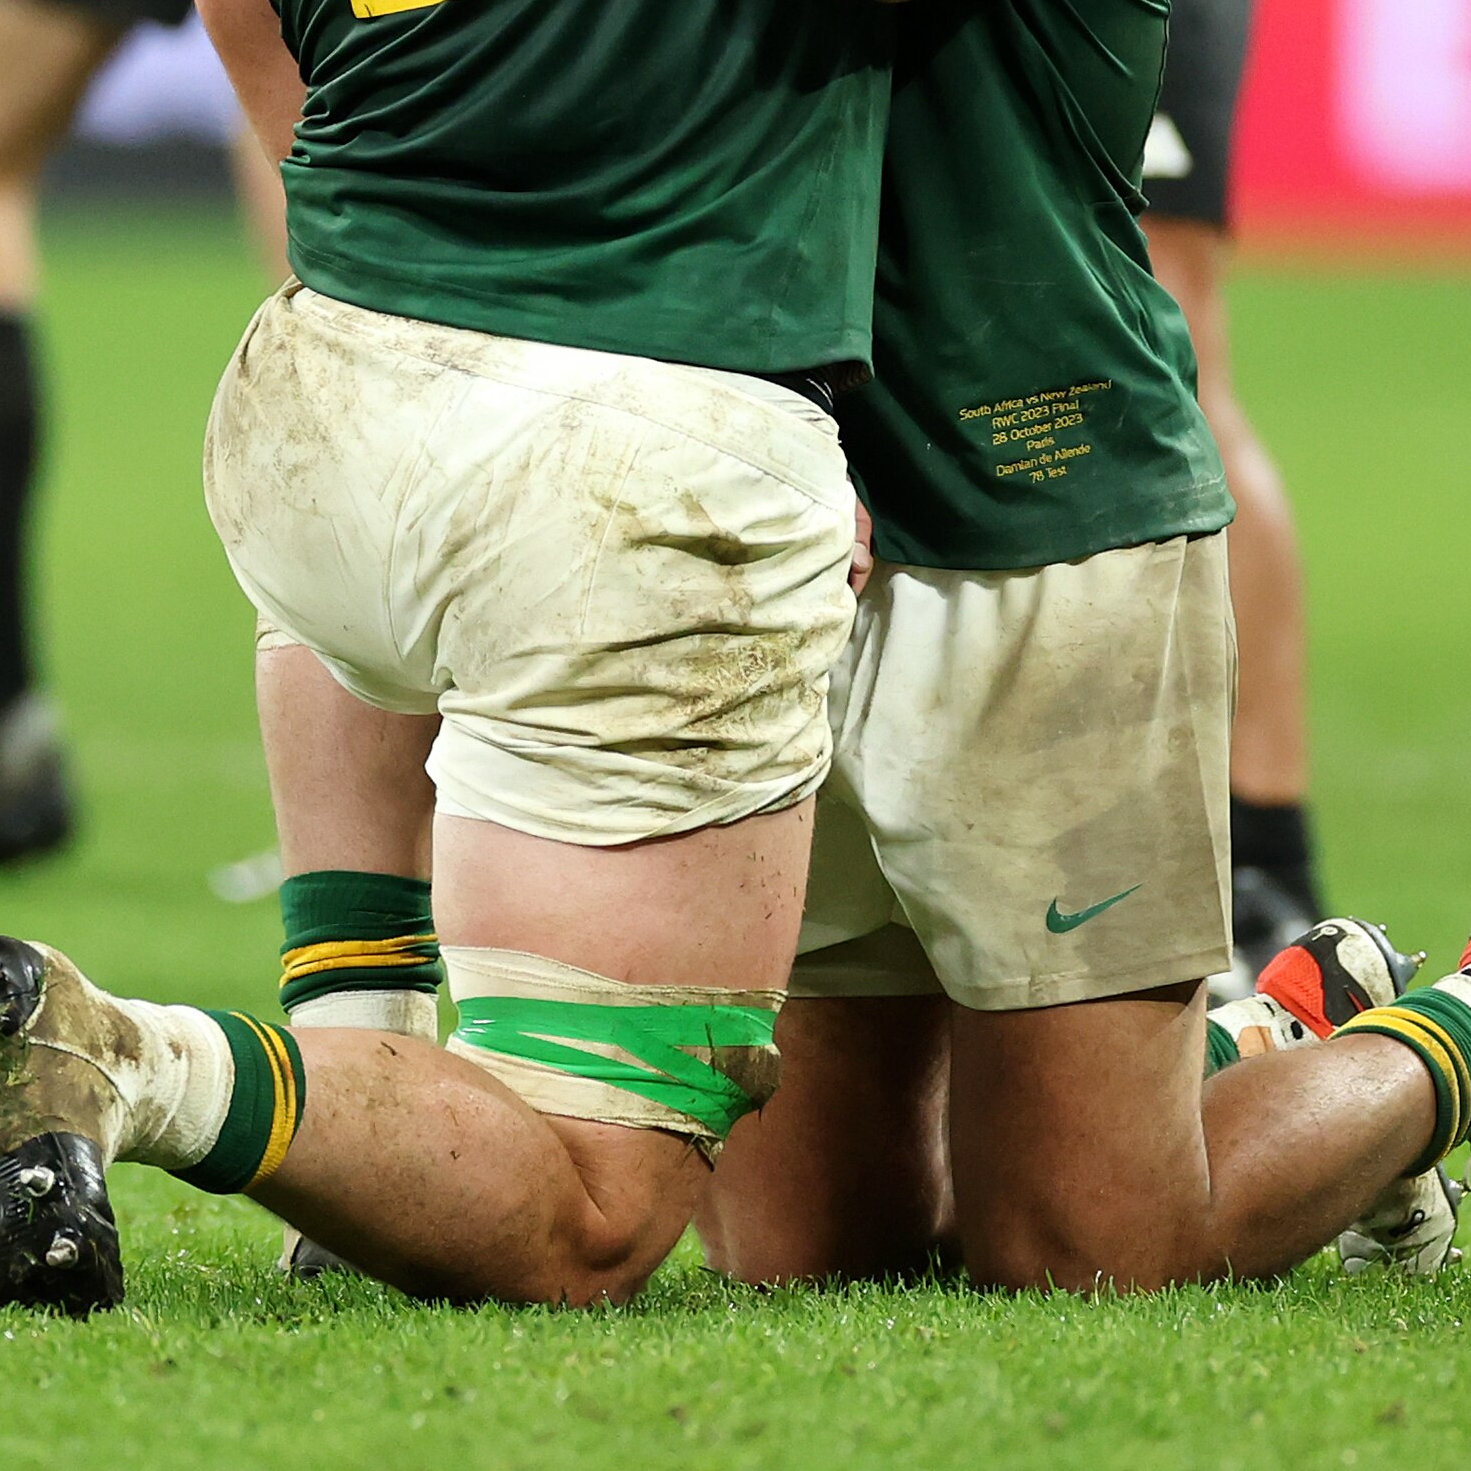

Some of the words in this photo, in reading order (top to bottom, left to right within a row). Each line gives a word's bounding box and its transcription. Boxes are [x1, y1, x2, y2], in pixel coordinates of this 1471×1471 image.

[959, 405, 991, 421] South
[993, 399, 1023, 413] Africa
[1025, 395, 1039, 405] vs
[1040, 390, 1067, 402] New
[992, 413, 1019, 429] RWC
[1020, 405, 1049, 422] 2023
[1052, 399, 1079, 414] Final
[992, 432, 1008, 445] 28
[1010, 423, 1053, 440] October
[1054, 413, 1084, 429] 2023
[1026, 436, 1056, 451] Paris
[996, 458, 1038, 477] Damian
[1039, 453, 1053, 465] de
[1055, 443, 1091, 461] Allende
[1029, 470, 1045, 484] 78
[1045, 465, 1068, 478] Test
